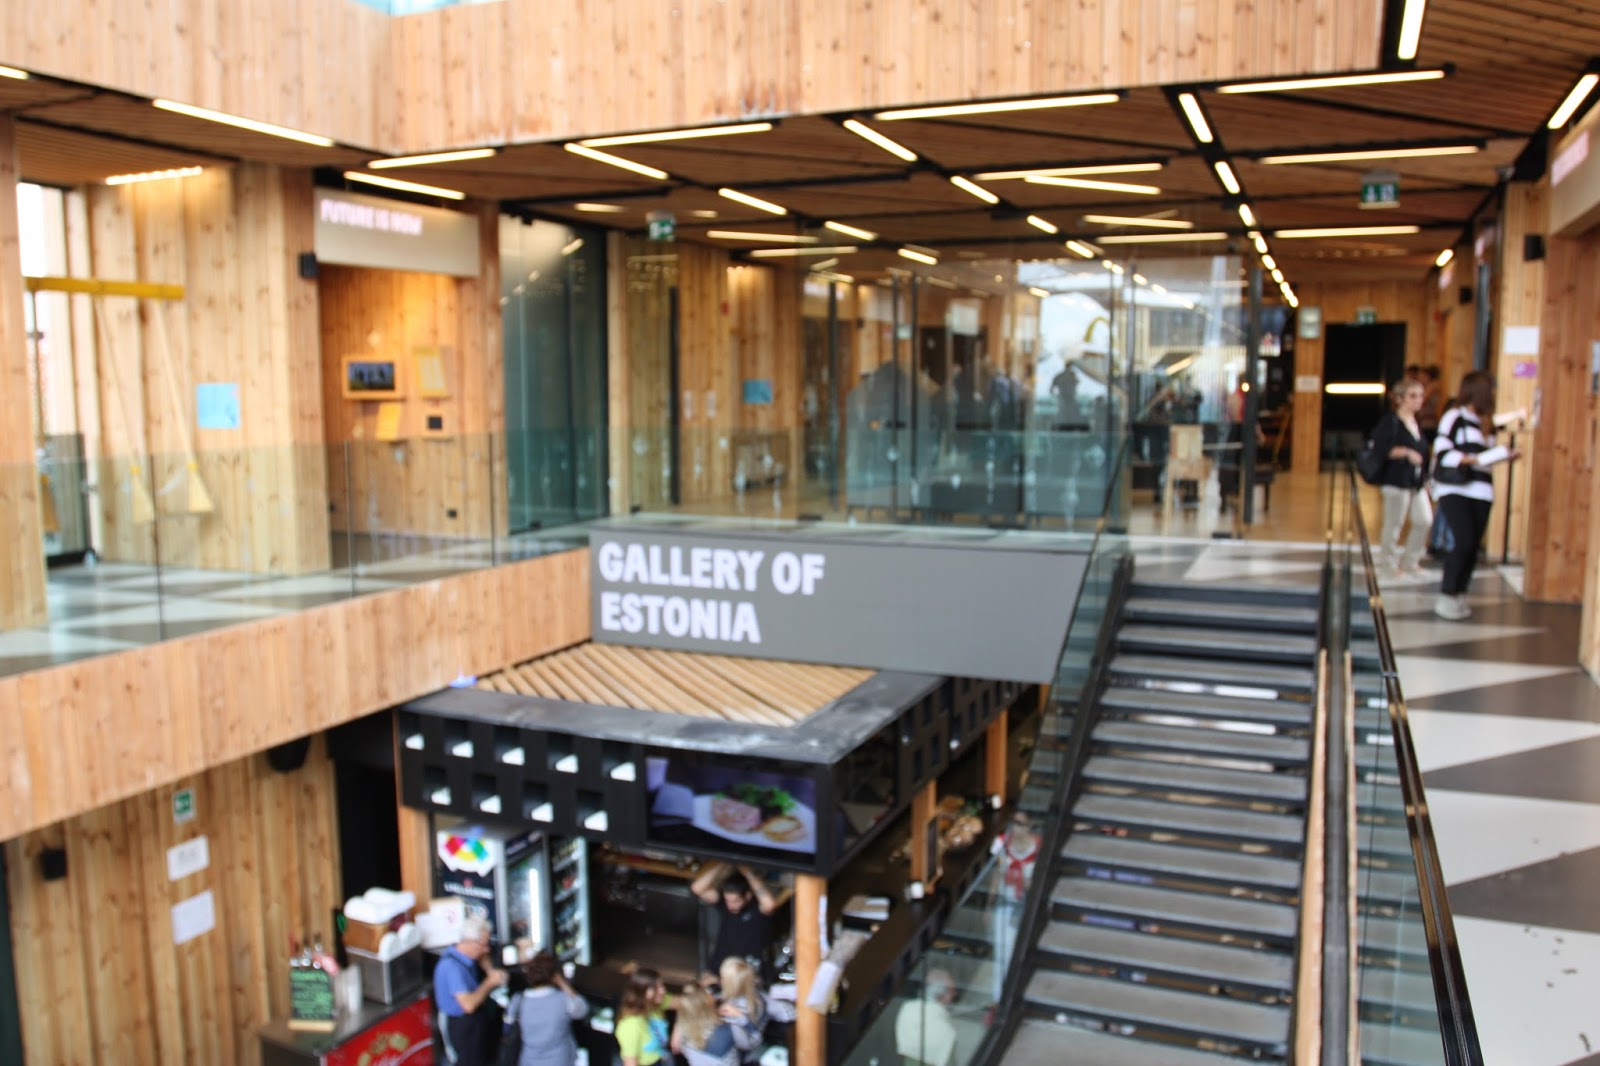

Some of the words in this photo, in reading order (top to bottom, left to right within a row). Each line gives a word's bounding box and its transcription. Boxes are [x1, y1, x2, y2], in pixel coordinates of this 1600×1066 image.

[321, 199, 374, 229] FUTURE
[599, 541, 764, 592] GALLERY
[771, 551, 825, 595] OF
[600, 591, 761, 644] ESTONIA
